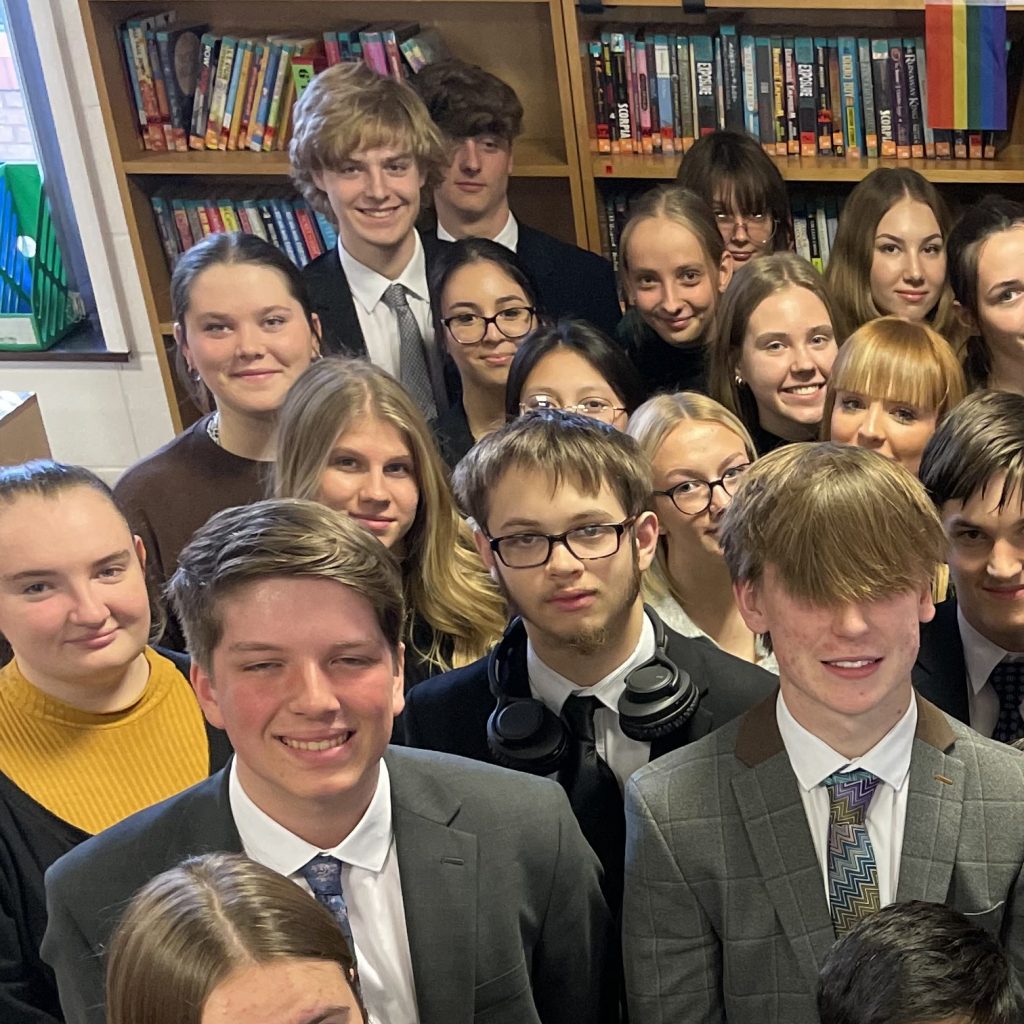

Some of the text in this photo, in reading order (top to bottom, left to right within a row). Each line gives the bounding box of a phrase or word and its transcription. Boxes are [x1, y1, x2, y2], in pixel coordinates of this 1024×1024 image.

[697, 62, 713, 96] EXPOSURE
[797, 64, 813, 97] EXPOSURE
[904, 54, 916, 97] RUNAWAY
[617, 103, 631, 139] SCORPIA
[908, 97, 919, 120] KING
